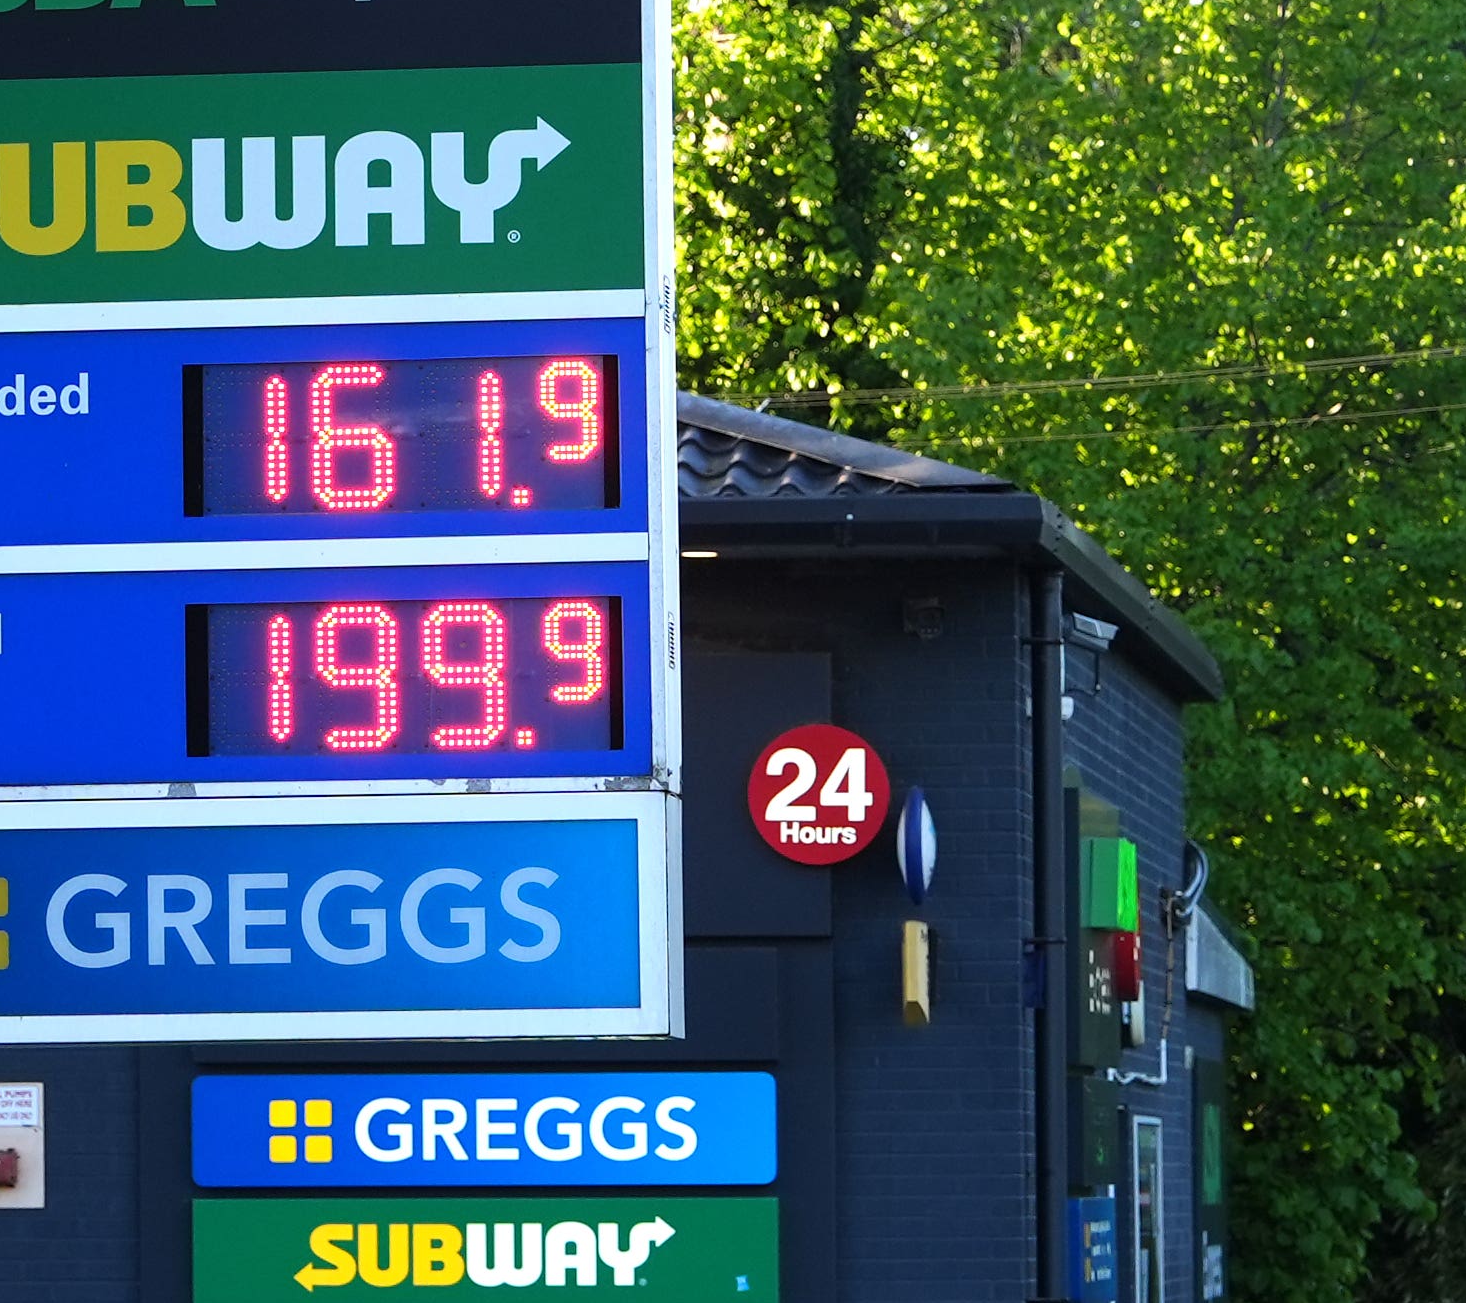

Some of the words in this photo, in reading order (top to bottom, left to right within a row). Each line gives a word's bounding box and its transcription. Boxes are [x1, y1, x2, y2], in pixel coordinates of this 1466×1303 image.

[263, 358, 601, 510] 161.9
[268, 600, 605, 750] 199.9
[764, 747, 873, 822] 24
[779, 820, 857, 846] Hours
[44, 866, 561, 971] GREGGS
[354, 1096, 699, 1162] GREGGS
[293, 1215, 677, 1293] SUBWAY
